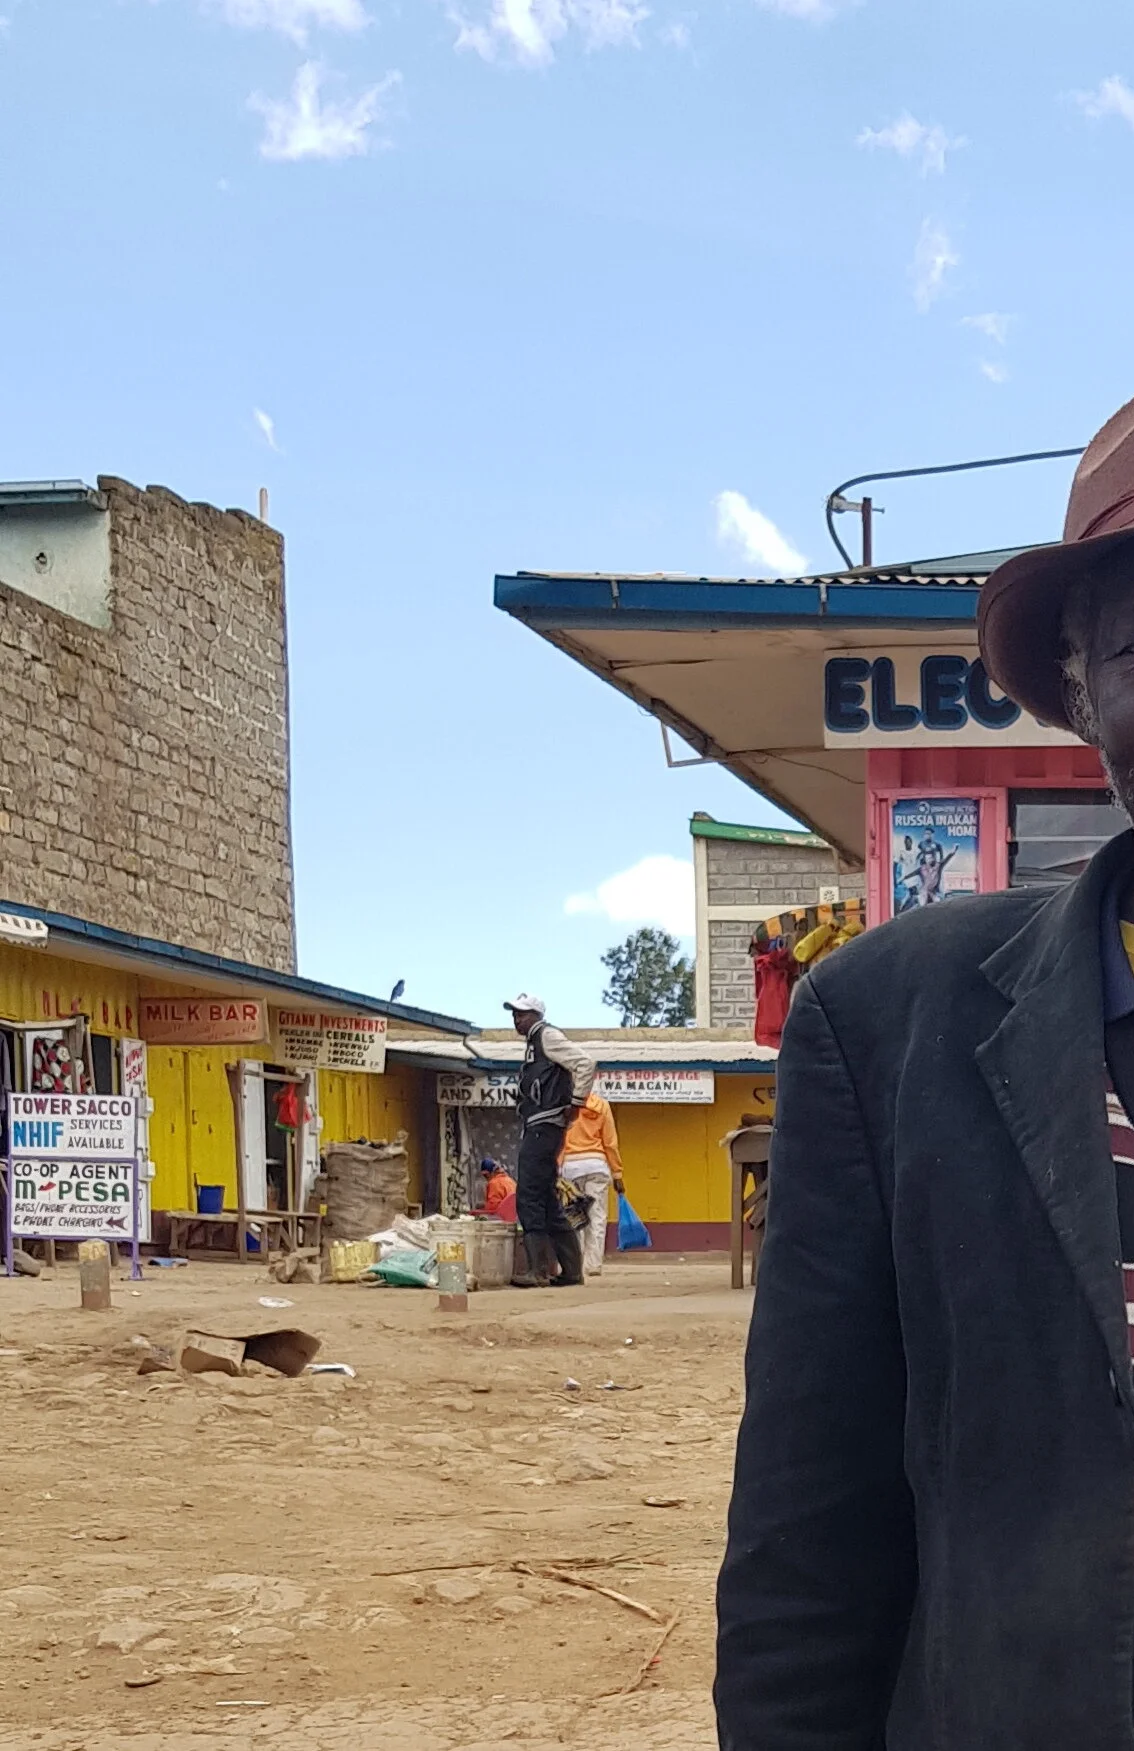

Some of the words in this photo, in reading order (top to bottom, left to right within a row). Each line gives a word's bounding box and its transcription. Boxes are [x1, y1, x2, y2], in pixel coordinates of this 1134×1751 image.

[825, 655, 1050, 734] ELEC
[895, 815, 934, 826] RUSSIA
[146, 1004, 200, 1021] MILK
[209, 1004, 258, 1021] BAR
[320, 1014, 386, 1033] INVESTMENTS
[326, 1030, 375, 1043] CEREALS
[488, 1075, 519, 1086] SA
[626, 1070, 659, 1080] SHOP
[663, 1070, 701, 1080] STAGE
[440, 1088, 472, 1100] AND
[480, 1088, 519, 1102] KIN
[13, 1097, 72, 1115] TOWER
[76, 1099, 132, 1117] SACCO
[13, 1120, 64, 1147] NHIF
[70, 1119, 123, 1131] SERVICES
[67, 1136, 124, 1149] AVAILABLE
[13, 1163, 59, 1178] CO-OP
[69, 1165, 132, 1180] AGENT
[22, 1215, 55, 1227] PHONE
